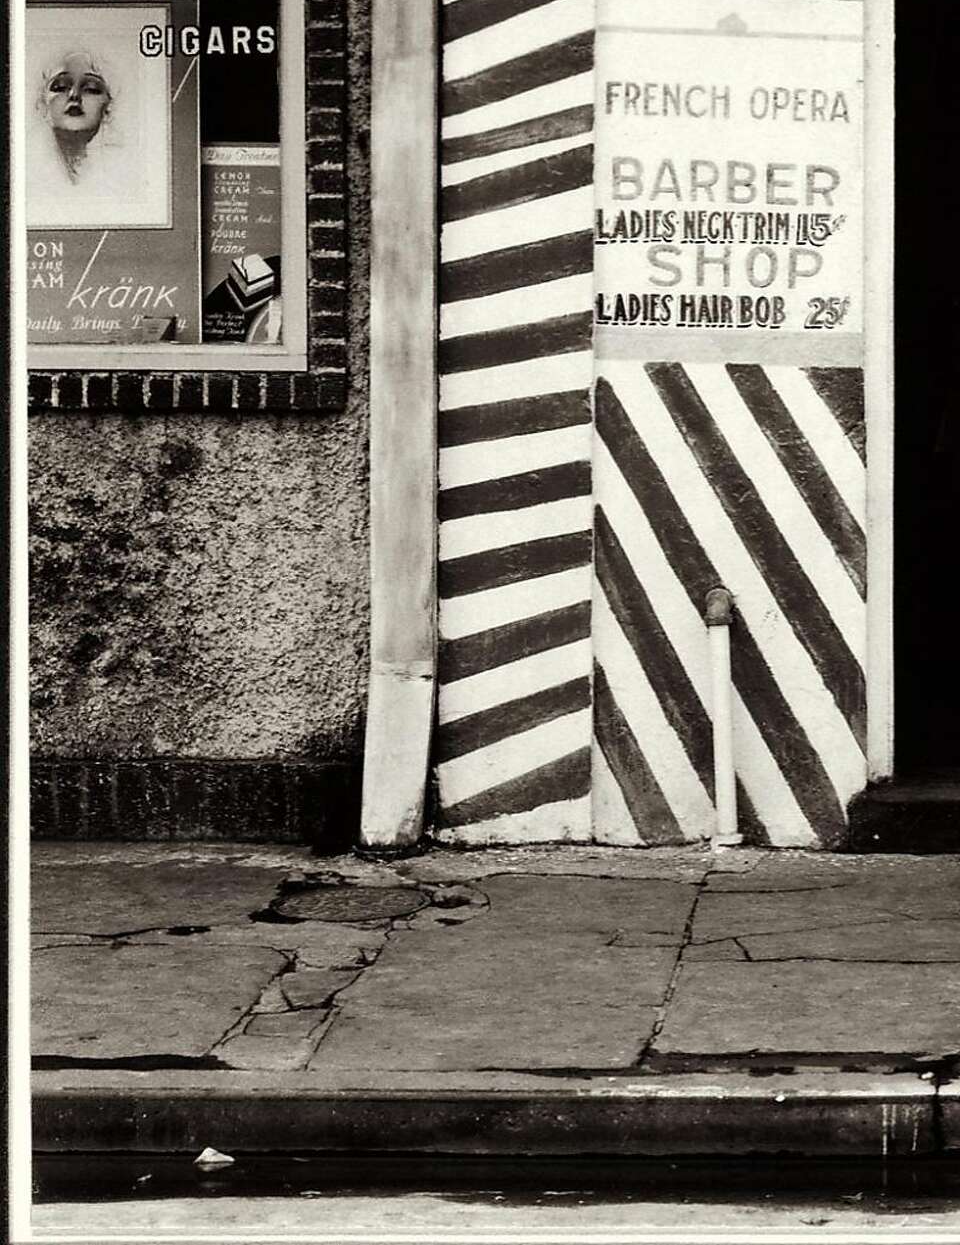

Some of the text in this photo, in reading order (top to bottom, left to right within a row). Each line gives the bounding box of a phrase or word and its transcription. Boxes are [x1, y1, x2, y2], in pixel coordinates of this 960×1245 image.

[140, 25, 276, 57] CIGARS
[605, 81, 850, 123] FRENCH OPERA
[611, 156, 841, 206] BARBER
[595, 209, 677, 244] LADIES
[681, 211, 734, 244] NECK
[736, 212, 790, 244] TRIM
[65, 230, 179, 308] kränk
[647, 244, 824, 289] SHOP
[595, 293, 673, 326] LADIES
[676, 294, 733, 327] HAIR
[737, 296, 786, 329] BOB
